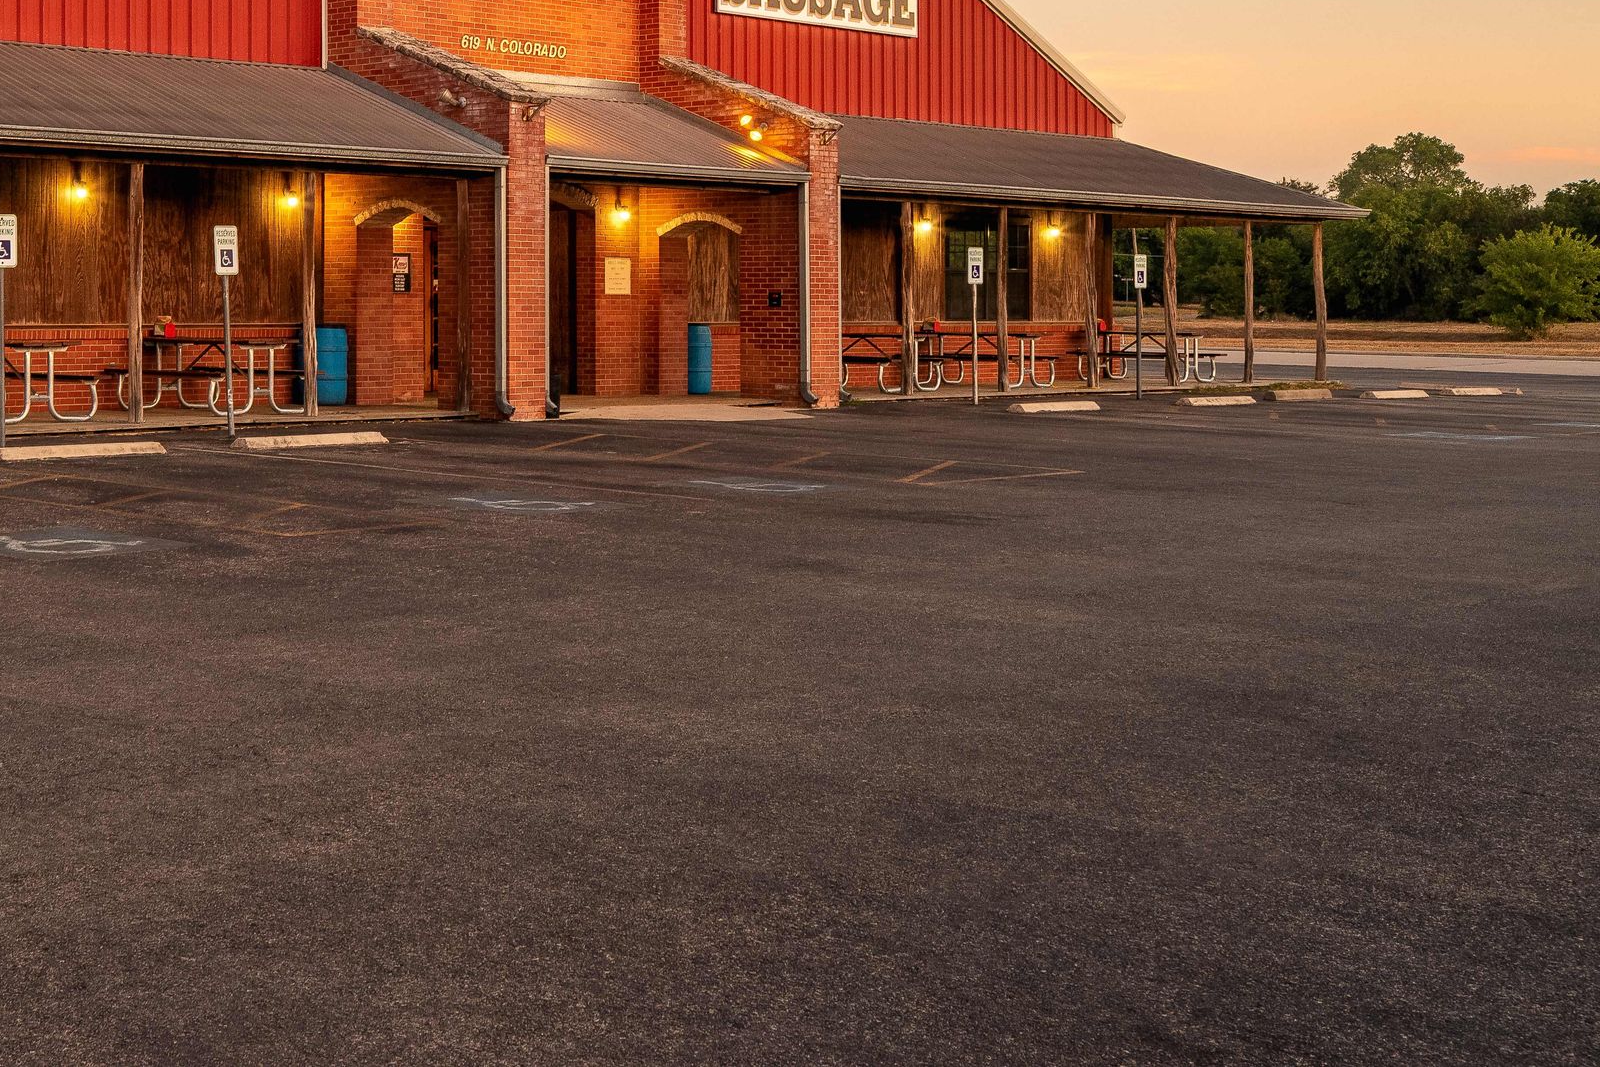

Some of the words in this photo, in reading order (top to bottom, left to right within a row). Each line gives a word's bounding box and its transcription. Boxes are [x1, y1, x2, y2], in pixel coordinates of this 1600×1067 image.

[461, 34, 481, 50] 619
[485, 37, 497, 52] N.
[500, 39, 567, 59] COLORADO
